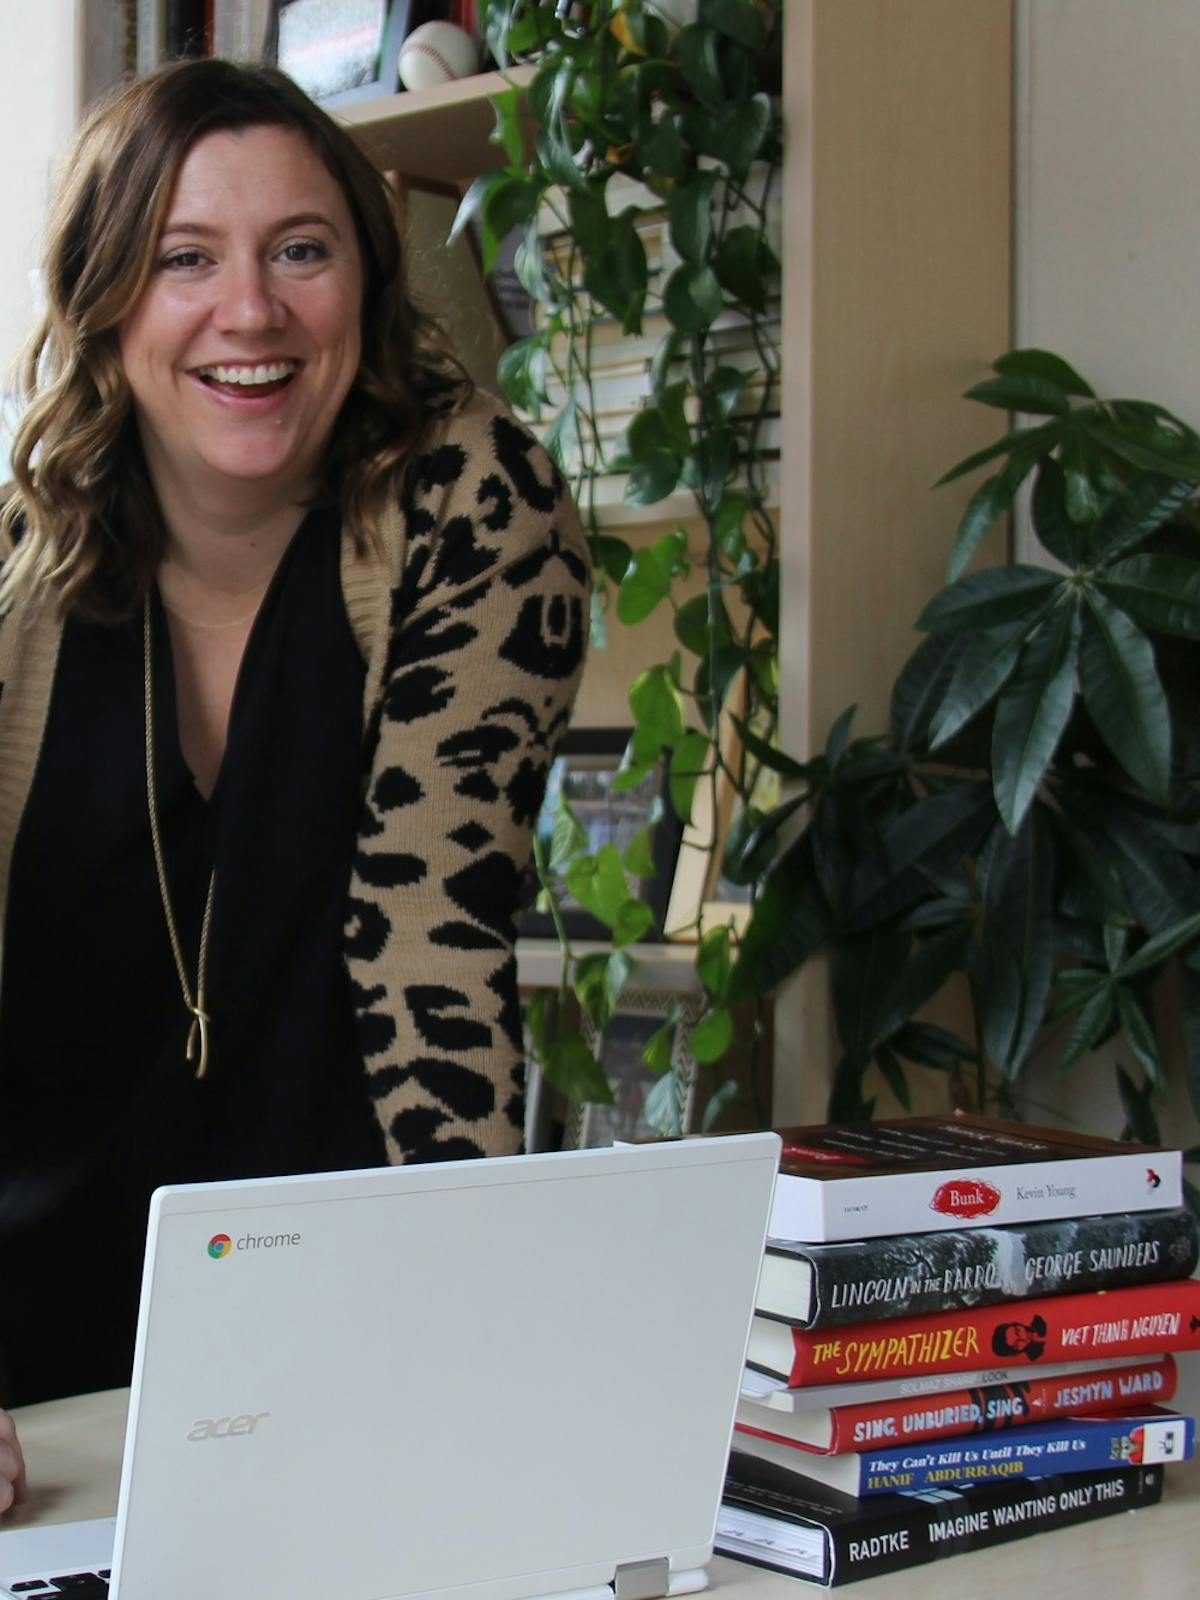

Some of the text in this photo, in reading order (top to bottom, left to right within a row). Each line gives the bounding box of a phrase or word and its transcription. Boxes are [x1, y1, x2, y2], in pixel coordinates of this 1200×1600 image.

[950, 1184, 1076, 1206] Bunk Kevin Young
[236, 1232, 301, 1250] chrome
[831, 1241, 1160, 1308] LINCOLN IN THE BARDO GEORGE SAUNDERS
[813, 1312, 1180, 1375] THE SYMPATHIZER VIET THANH NGUYEN
[982, 1371, 1008, 1383] LOOK
[903, 1403, 983, 1433] UNBURIED,
[986, 1397, 1023, 1419] SING
[1054, 1380, 1113, 1408] JESMYN
[1119, 1371, 1163, 1396] WARD
[186, 1412, 270, 1441] acer
[869, 1460, 899, 1472] They
[938, 1452, 962, 1465] Kill
[964, 1450, 978, 1462] Us
[982, 1446, 1012, 1460] Until
[1016, 1444, 1043, 1457] They
[1047, 1440, 1069, 1453] Kill
[1072, 1438, 1087, 1450] Us
[867, 1461, 1024, 1489] HANIF ABDURRAQIB
[849, 1530, 909, 1562] RADTKE
[928, 1511, 989, 1543] IMAGINE
[992, 1495, 1056, 1527] WANTING
[1059, 1485, 1094, 1511] ONLY
[1095, 1479, 1125, 1501] THIS
